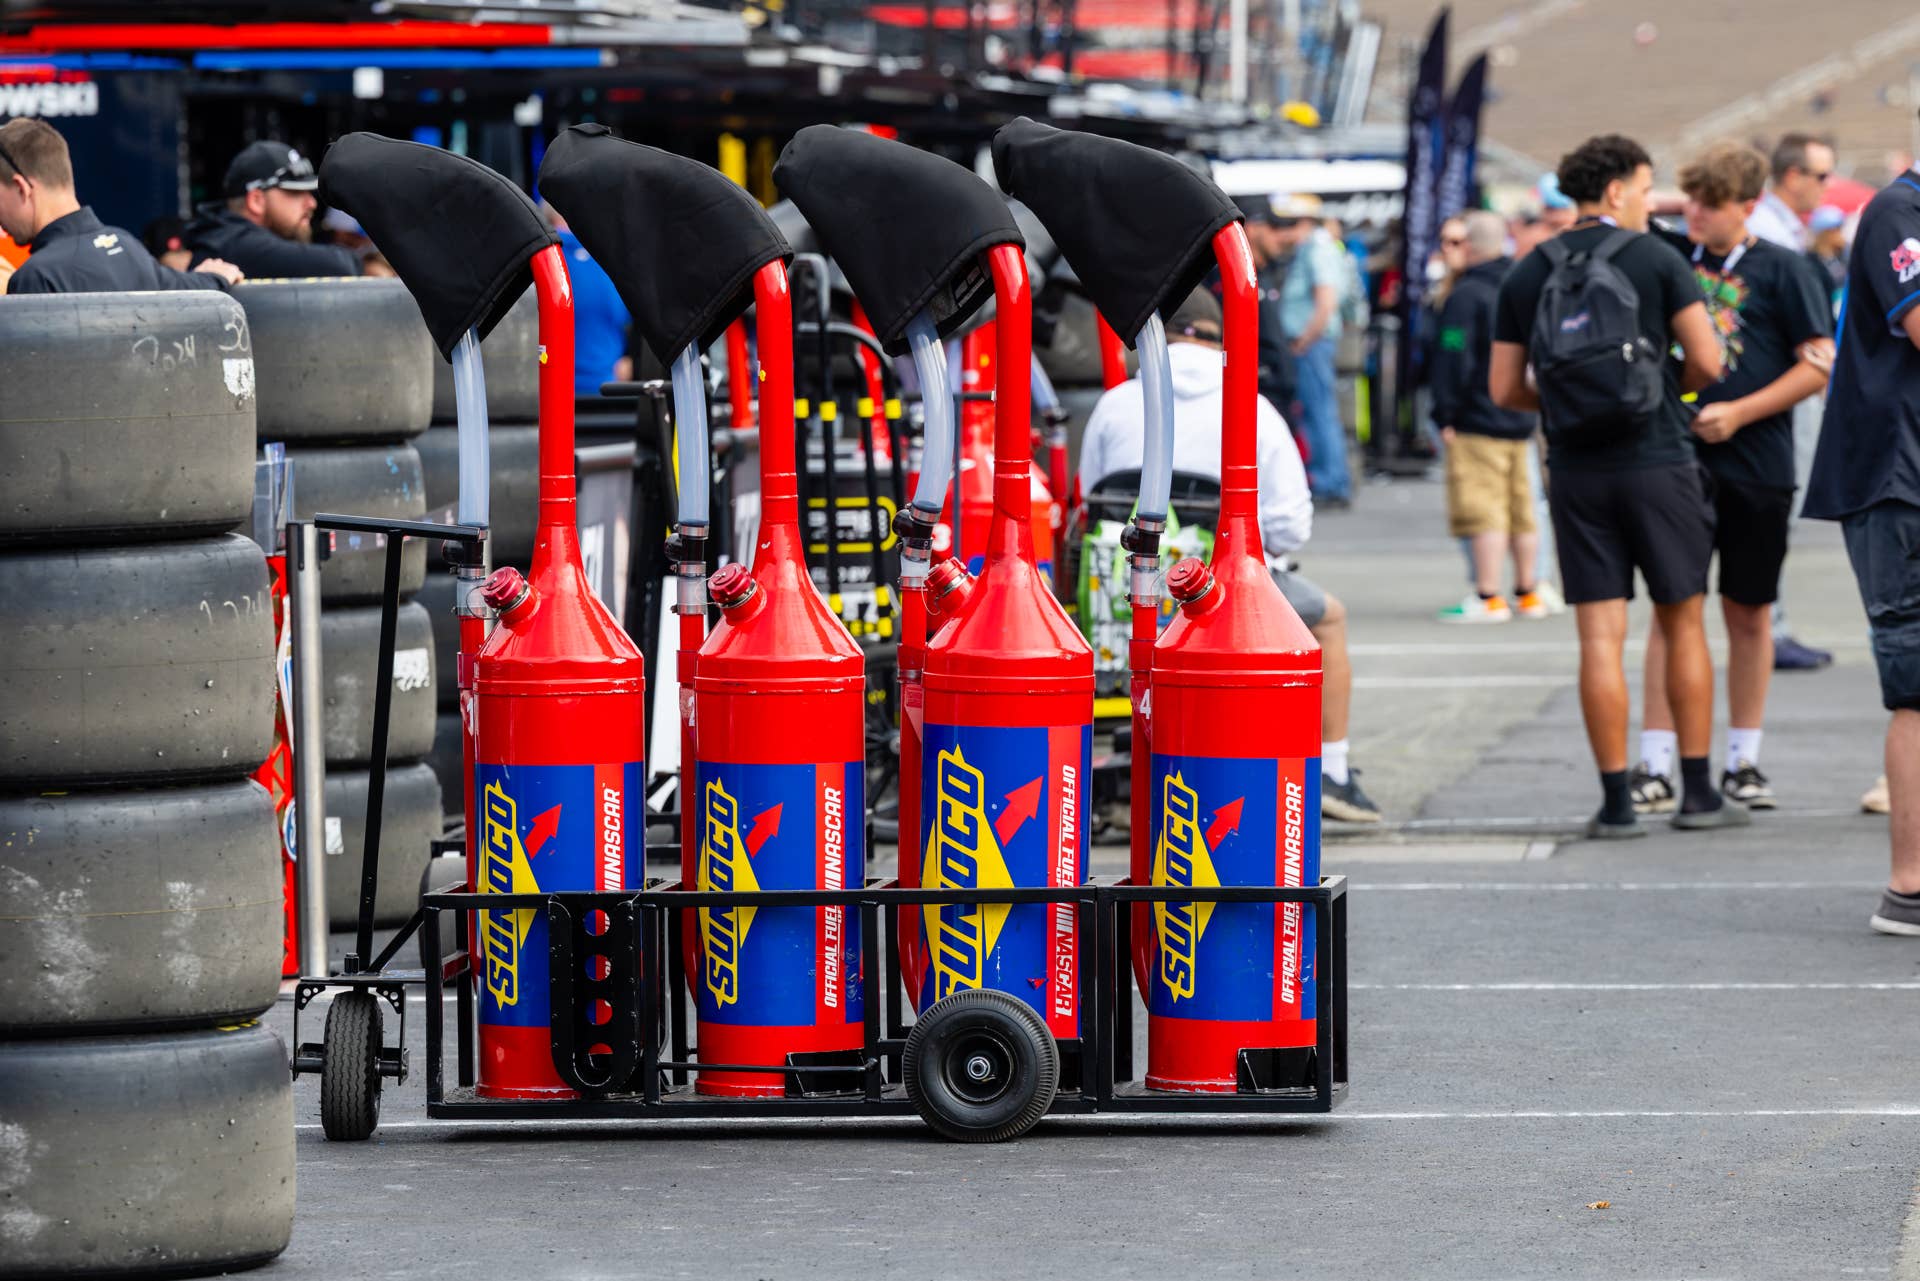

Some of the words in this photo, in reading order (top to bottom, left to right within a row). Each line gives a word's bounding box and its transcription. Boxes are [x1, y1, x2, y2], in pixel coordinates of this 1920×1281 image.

[1139, 688, 1151, 720] 4
[603, 787, 621, 875] NASCAR
[824, 786, 842, 874] NASCAR
[1061, 764, 1076, 847] OFFICIAL
[1284, 782, 1302, 870] NASCAR
[487, 787, 515, 1000] SUNOCO
[708, 786, 735, 999] SUNOCO
[1163, 780, 1194, 993] SUNOCO
[824, 944, 838, 1008] OFFICIAL
[1055, 928, 1074, 1017] NASCAR
[1281, 940, 1297, 1004] OFFICIAL
